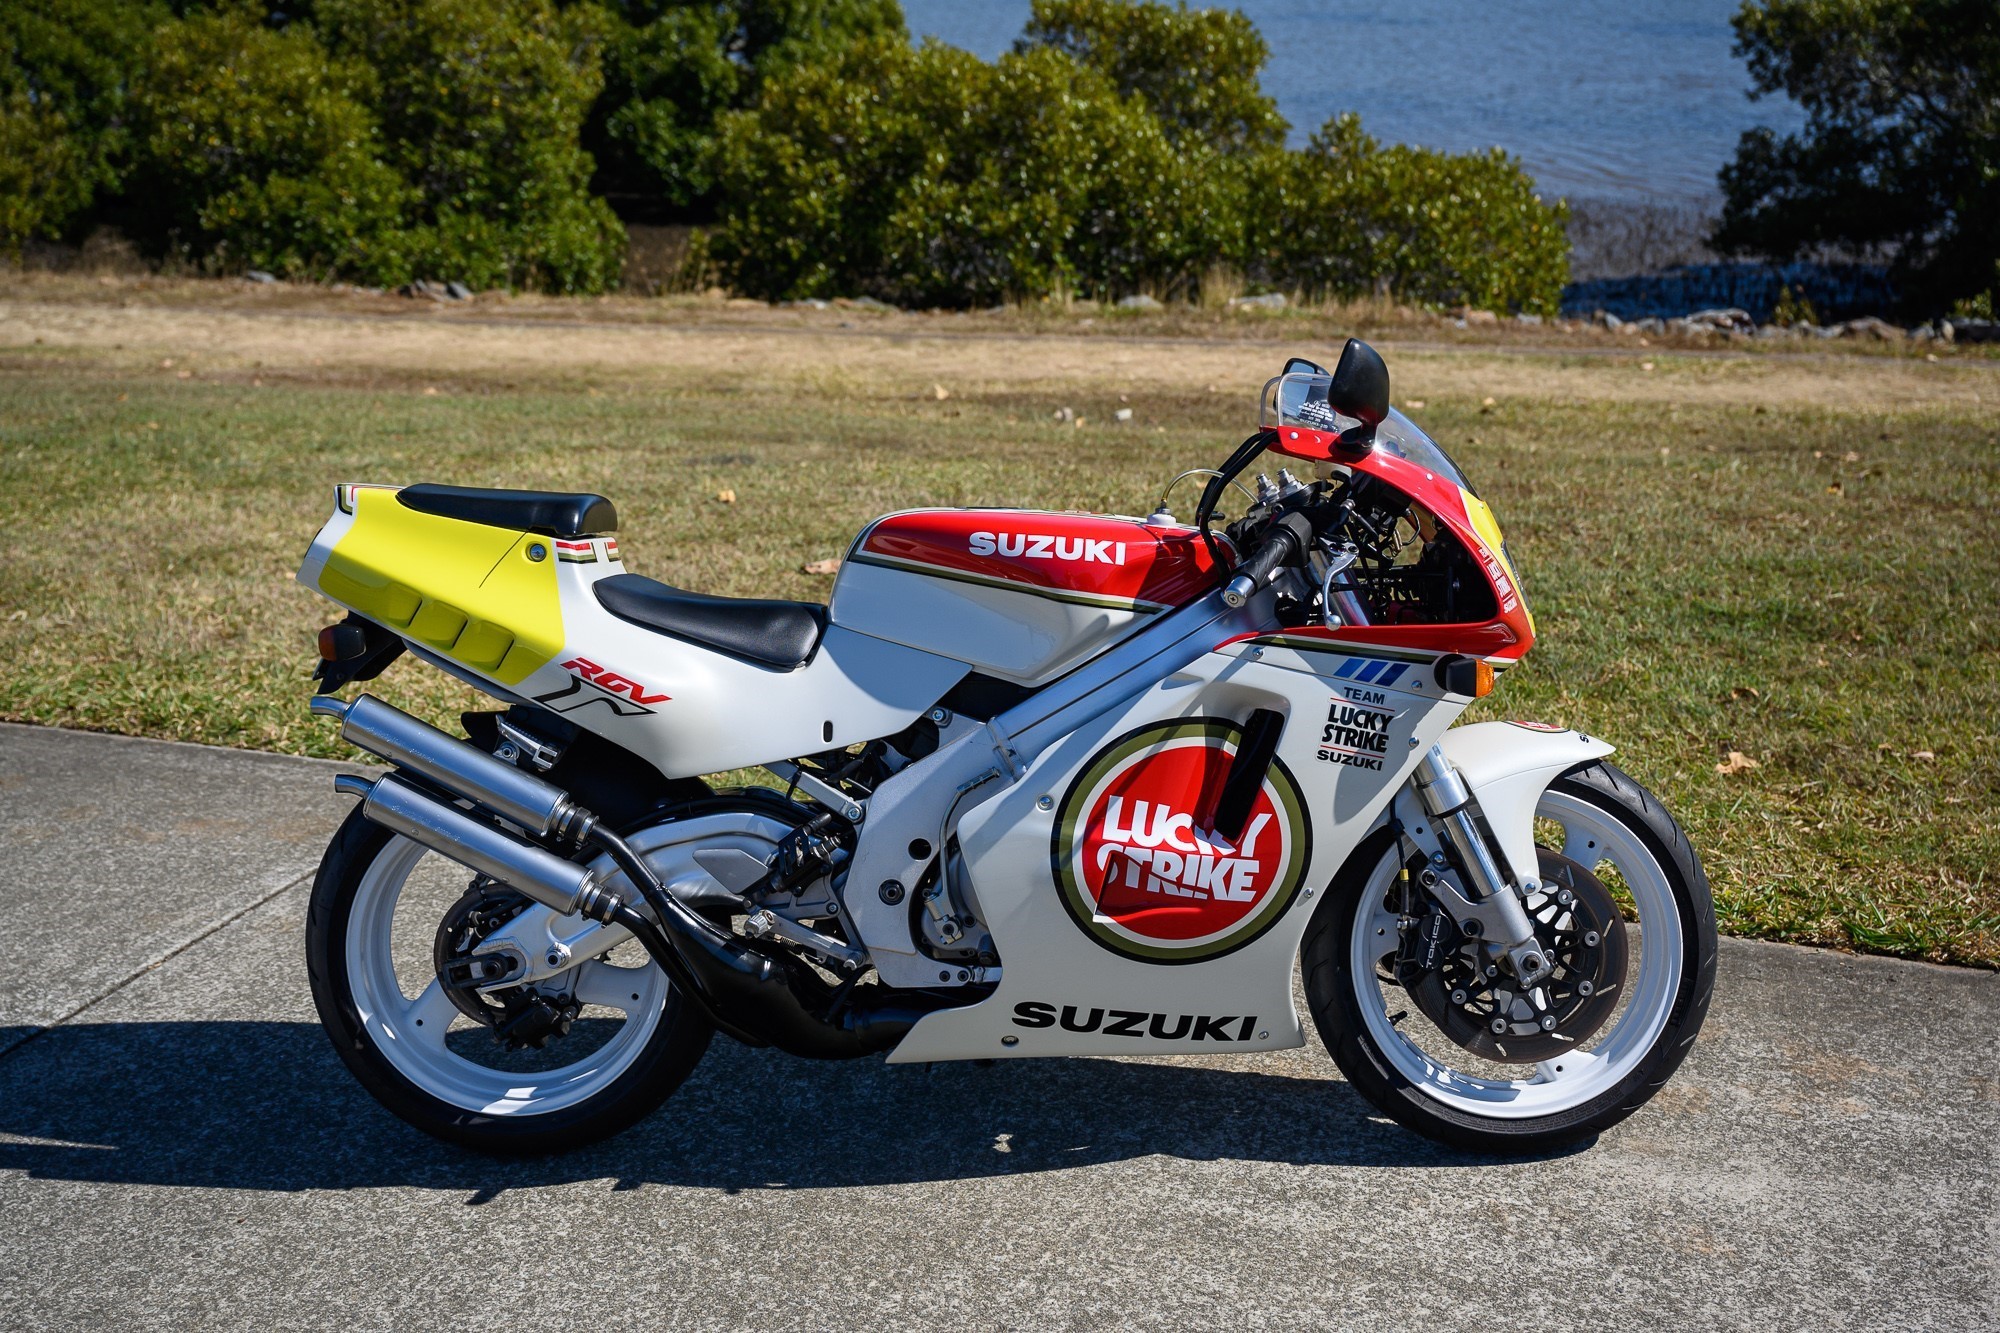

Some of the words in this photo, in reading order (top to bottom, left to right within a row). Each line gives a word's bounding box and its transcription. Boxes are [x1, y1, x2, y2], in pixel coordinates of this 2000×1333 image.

[969, 531, 1126, 566] SUZUKI
[560, 657, 672, 704] RGV
[1344, 686, 1385, 705] TEAM
[1328, 704, 1394, 733] LUCKY
[1322, 724, 1389, 753] STRIKE
[1317, 750, 1383, 771] SUZUKI
[1425, 914, 1442, 969] TOKICO
[1012, 1001, 1258, 1042] SUZUKI
